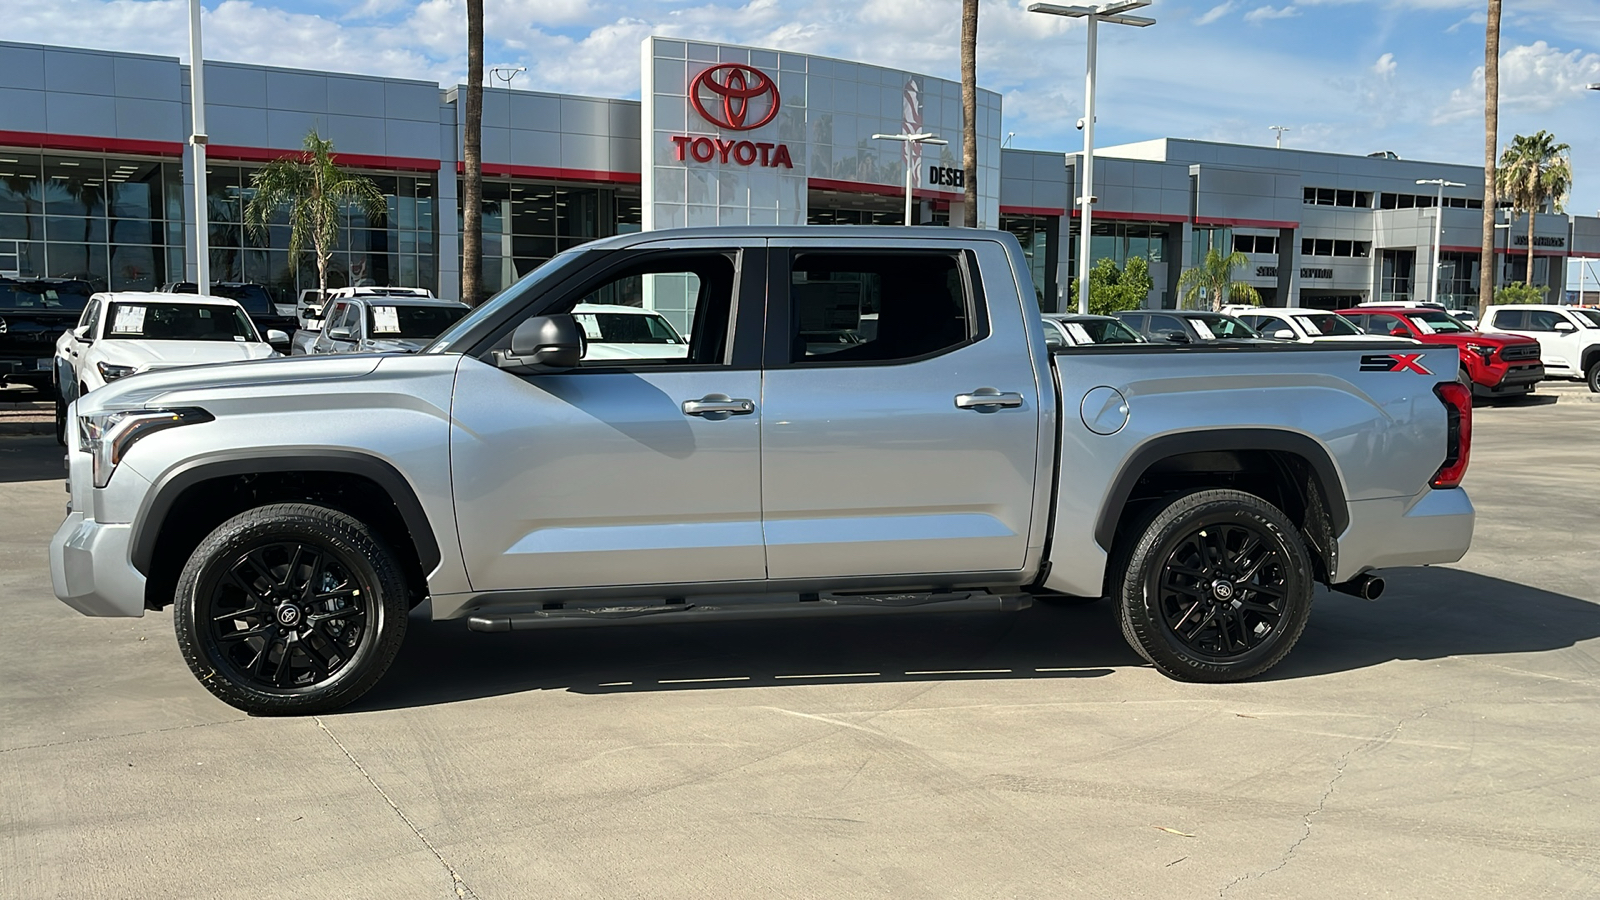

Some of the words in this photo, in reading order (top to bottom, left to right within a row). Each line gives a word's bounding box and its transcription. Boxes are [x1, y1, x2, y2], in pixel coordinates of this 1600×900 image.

[671, 136, 793, 168] TOYOTA
[930, 166, 965, 188] DESER
[1255, 266, 1279, 277] SERV
[1359, 354, 1436, 375] SX
